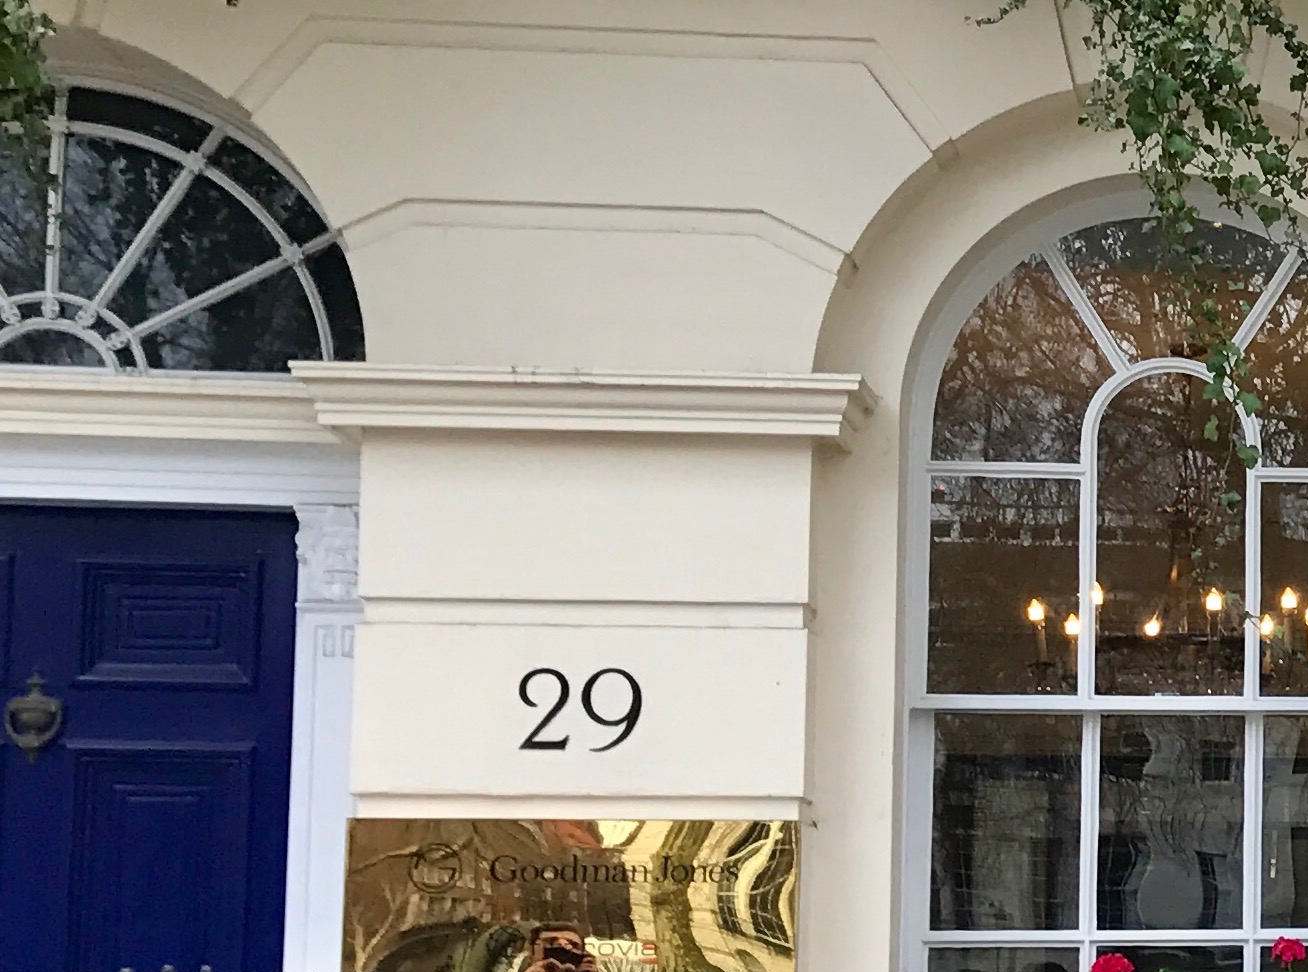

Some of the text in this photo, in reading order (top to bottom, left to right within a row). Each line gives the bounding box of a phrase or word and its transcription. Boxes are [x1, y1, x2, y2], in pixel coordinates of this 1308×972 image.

[517, 667, 643, 752] 29
[489, 853, 650, 884] Goodman
[656, 854, 740, 884] Jones
